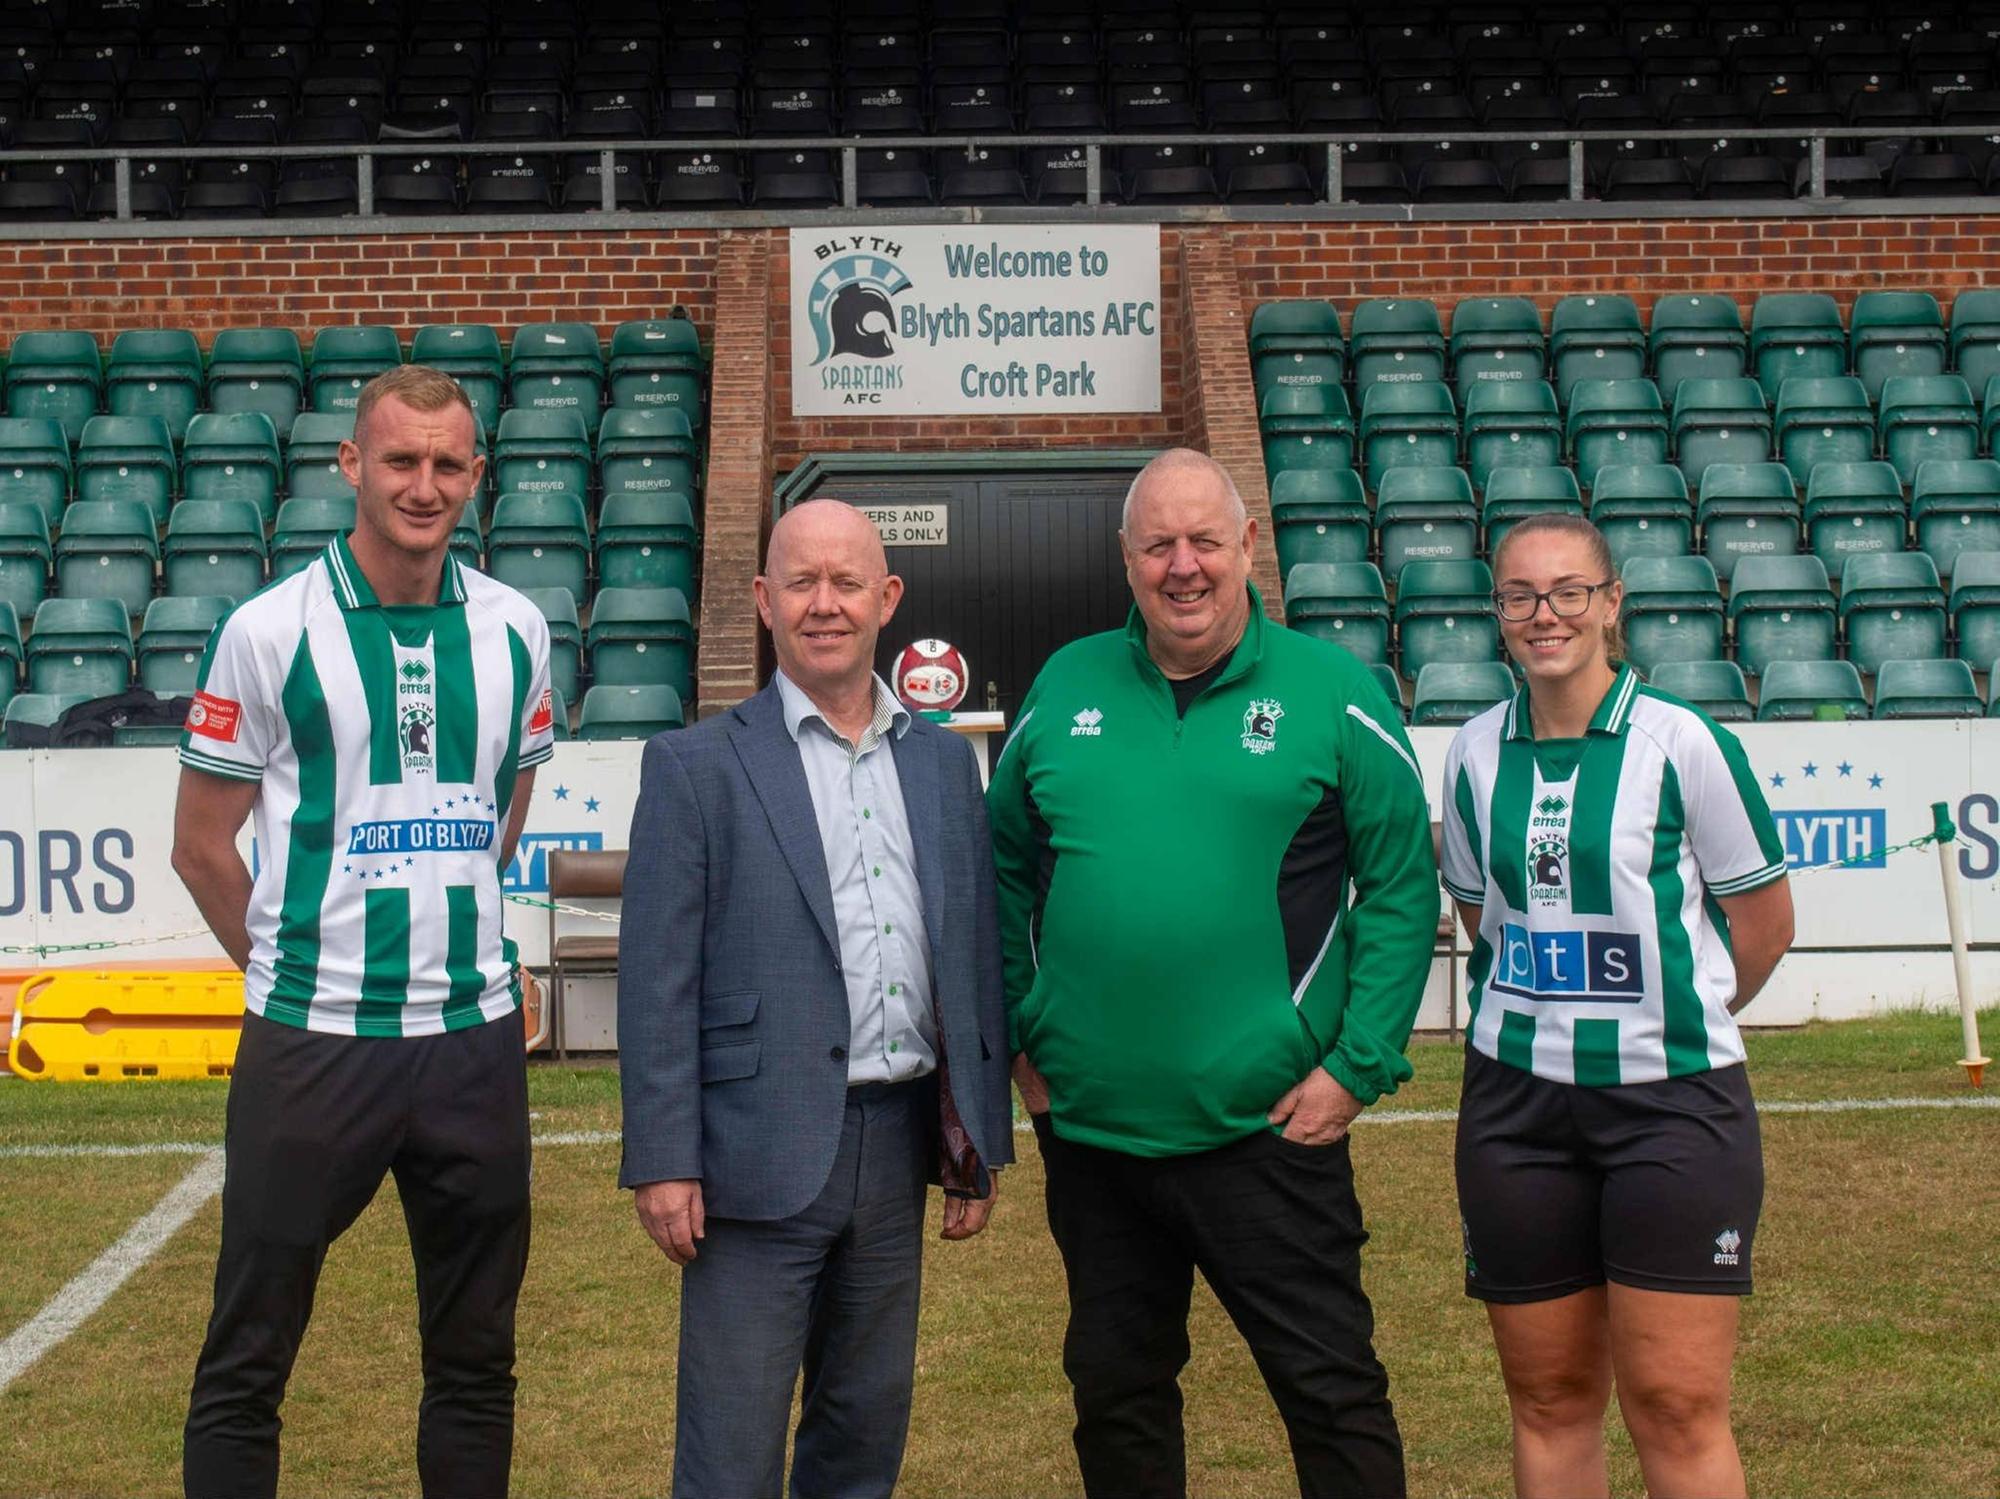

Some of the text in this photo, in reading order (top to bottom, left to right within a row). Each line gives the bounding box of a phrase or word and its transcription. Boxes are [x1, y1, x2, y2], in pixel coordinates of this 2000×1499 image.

[586, 165, 628, 174] RESVED
[677, 165, 720, 174] RESERVED
[814, 236, 903, 260] BLYTH
[944, 242, 1108, 278] Welcome to
[901, 301, 1154, 346] Blyth Spartans AFC
[822, 365, 903, 390] SPARTANS
[960, 361, 1096, 398] Croft Park
[1277, 375, 1323, 384] RESERVED
[1377, 373, 1423, 383] RESERVED
[1477, 370, 1523, 380] RESERVED
[533, 397, 579, 407] RESERVED
[634, 393, 680, 402] RESERVED
[843, 393, 882, 404] AFC
[517, 481, 565, 491] RESERVED
[624, 479, 671, 490] RESERVED
[902, 510, 935, 522] AND
[903, 527, 944, 541] ONLY
[1726, 541, 1775, 551] RESERVED
[1834, 539, 1883, 550] RESERVED
[1404, 545, 1453, 556] RESERVED
[400, 682, 431, 695] errea
[401, 702, 433, 714] BLYTH
[1070, 726, 1102, 737] errea
[1532, 816, 1567, 828] errea
[352, 823, 489, 851] PORT OF BLYTH
[1531, 833, 1566, 845] BLYTH
